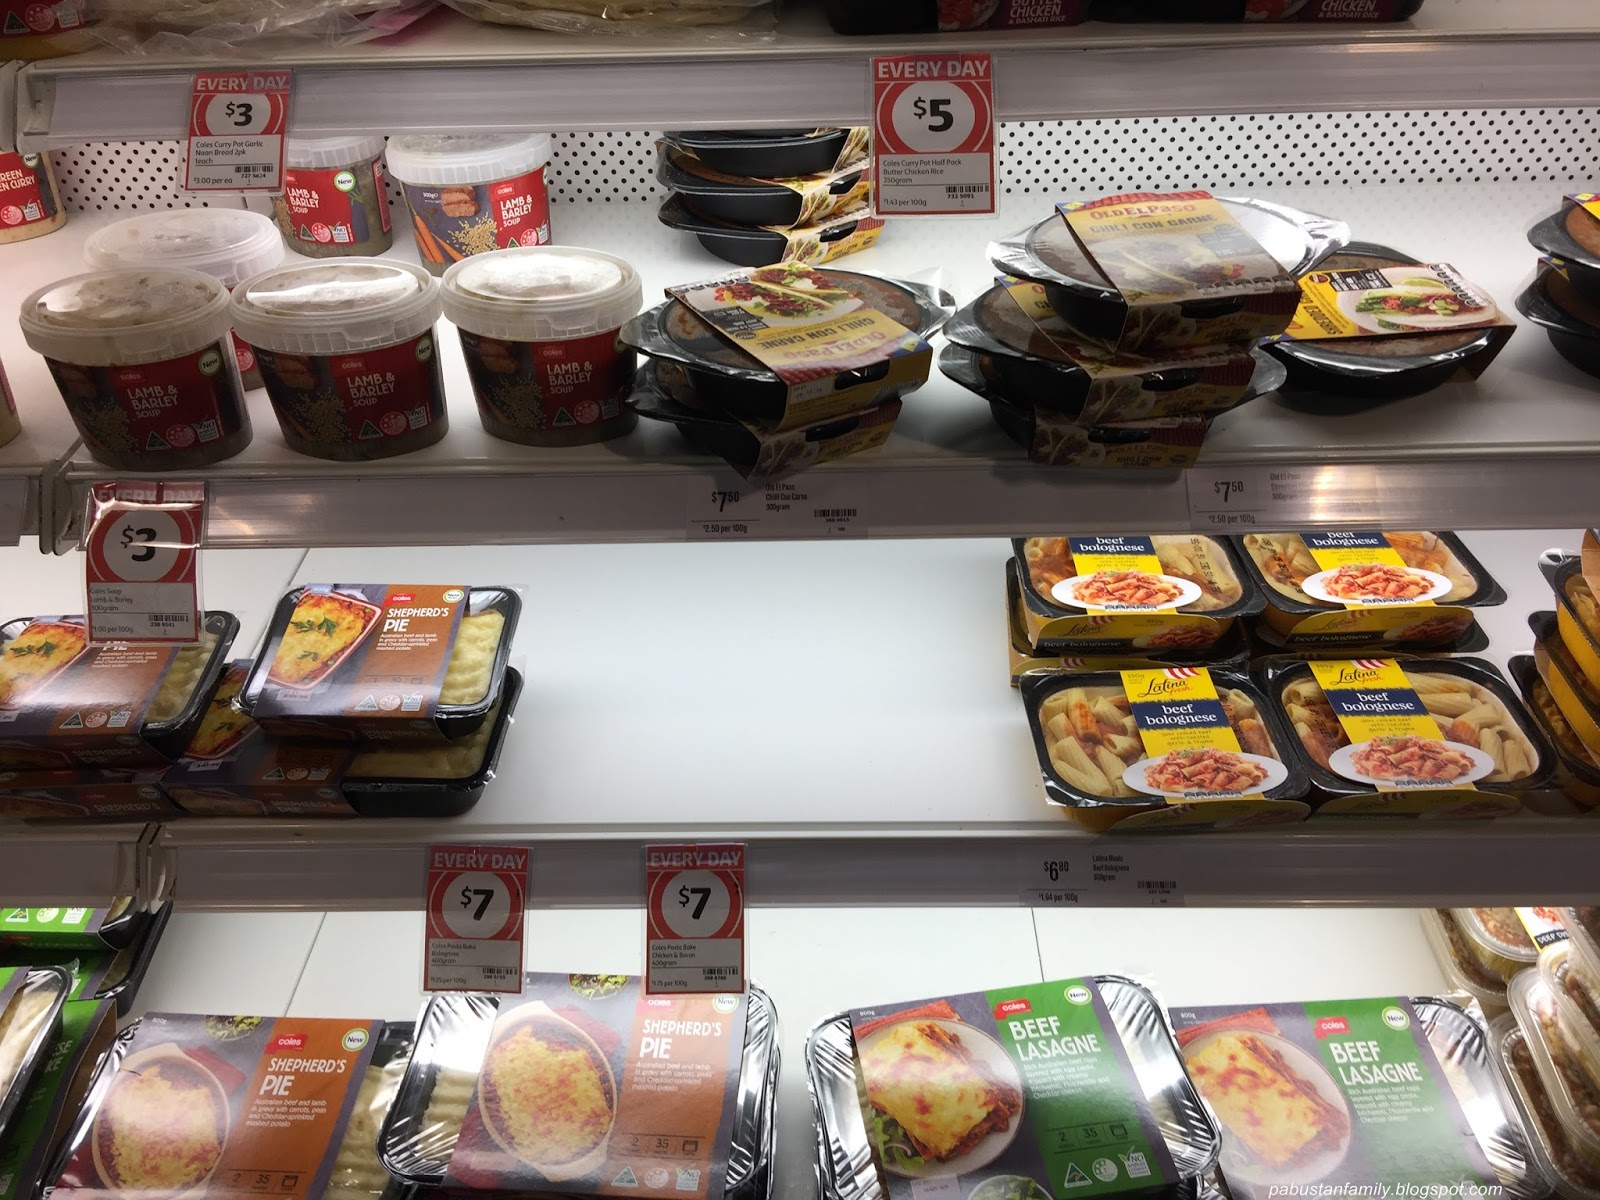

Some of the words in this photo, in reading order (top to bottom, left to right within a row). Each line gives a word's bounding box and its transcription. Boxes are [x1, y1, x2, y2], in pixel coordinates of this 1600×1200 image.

[1010, 5, 1062, 17] CHICKEN
[1322, 0, 1376, 12] CHICKEN
[878, 62, 942, 78] EVERY
[947, 60, 988, 76] DAY
[196, 78, 250, 91] EVERY
[253, 76, 287, 90] DAY
[225, 101, 253, 126] $3
[914, 96, 954, 132] $5
[0, 169, 23, 182] REEN
[10, 175, 35, 190] CURRY
[287, 187, 310, 198] LAMB
[312, 191, 319, 199] &
[290, 197, 319, 208] BARLEY
[500, 198, 524, 210] LAMB
[526, 194, 532, 203] &
[502, 203, 532, 220] BARLEY
[503, 218, 520, 227] SOUP
[1132, 221, 1164, 230] CON
[1167, 214, 1214, 227] CARNE
[806, 328, 837, 339] CON
[419, 345, 430, 355] New
[757, 336, 806, 350] CARNE
[203, 358, 218, 369] New
[546, 362, 580, 375] LAMB
[584, 361, 592, 371] &
[347, 373, 382, 388] LAMB
[386, 372, 395, 382] &
[549, 372, 592, 385] BARLEY
[127, 385, 163, 400] LAMB
[168, 385, 178, 394] &
[350, 382, 395, 398] BARLEY
[132, 395, 178, 410] BARLEY
[353, 398, 377, 407] SOUP
[136, 409, 160, 418] SOUP
[1208, 515, 1226, 523] $2.50
[1227, 516, 1237, 524] per
[1240, 515, 1255, 524] 100g
[703, 524, 719, 533] $2.50
[721, 525, 730, 533] per
[733, 524, 747, 533] 100g
[120, 525, 156, 562] $3
[1080, 544, 1145, 552] bolognese
[1313, 537, 1379, 547] bolognese
[387, 608, 449, 618] SHEPHERD'S
[383, 618, 410, 632] PIE
[1330, 668, 1379, 685] Latina
[1361, 675, 1384, 685] fresh
[1138, 678, 1189, 697] Latina
[1168, 686, 1193, 695] fresh
[1356, 692, 1389, 703] beef
[1162, 704, 1194, 714] beef
[1342, 701, 1415, 712] bolognese
[1146, 712, 1218, 726] bolognese
[435, 853, 488, 868] EVERY
[492, 854, 526, 869] DAY
[651, 852, 705, 866] EVERY
[708, 851, 742, 866] DAY
[1094, 874, 1115, 882] 350gram
[461, 886, 494, 921] $7
[679, 885, 711, 920] $7
[1054, 893, 1063, 902] per
[1065, 893, 1078, 902] 100g
[1002, 1003, 1026, 1012] coles
[1321, 1020, 1346, 1030] coles
[1387, 1014, 1404, 1022] New
[643, 1019, 722, 1036] SHEPHERD'S
[1008, 1016, 1061, 1041] BEEF
[640, 1037, 672, 1059] PIE
[1016, 1033, 1102, 1061] LASAGNE
[1329, 1041, 1381, 1063] BEEF
[268, 1058, 346, 1073] SHEPHERD'S
[1338, 1062, 1423, 1086] LASAGNE
[260, 1075, 295, 1096] PIE
[1059, 1132, 1067, 1142] 2
[1082, 1128, 1098, 1138] 35
[656, 1139, 668, 1148] 35
[256, 1174, 270, 1184] 35
